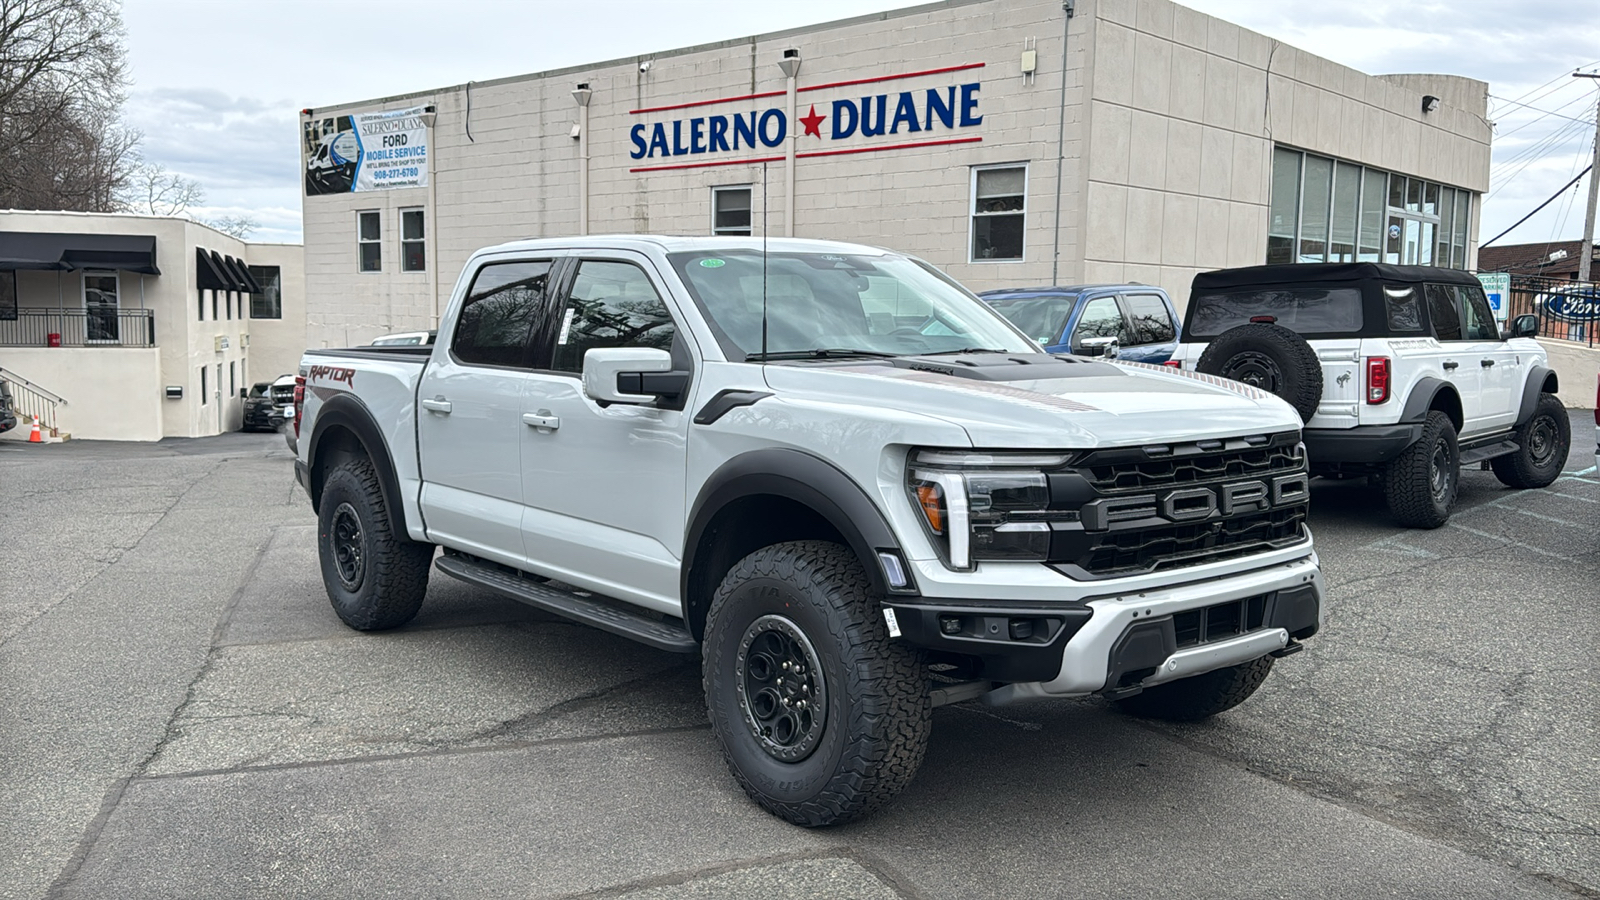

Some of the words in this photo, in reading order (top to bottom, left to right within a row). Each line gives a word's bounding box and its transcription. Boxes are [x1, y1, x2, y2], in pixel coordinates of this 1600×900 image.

[362, 120, 395, 135] SALERNO
[630, 108, 787, 160] SALERNO
[831, 82, 984, 140] DUANE
[382, 133, 408, 148] FORD
[366, 149, 394, 161] MOBILE
[394, 146, 426, 159] SERVICE
[398, 159, 410, 167] SHOP
[373, 167, 419, 180] 908-277-6780
[308, 364, 357, 390] RAPTOR
[1081, 472, 1310, 534] FORD
